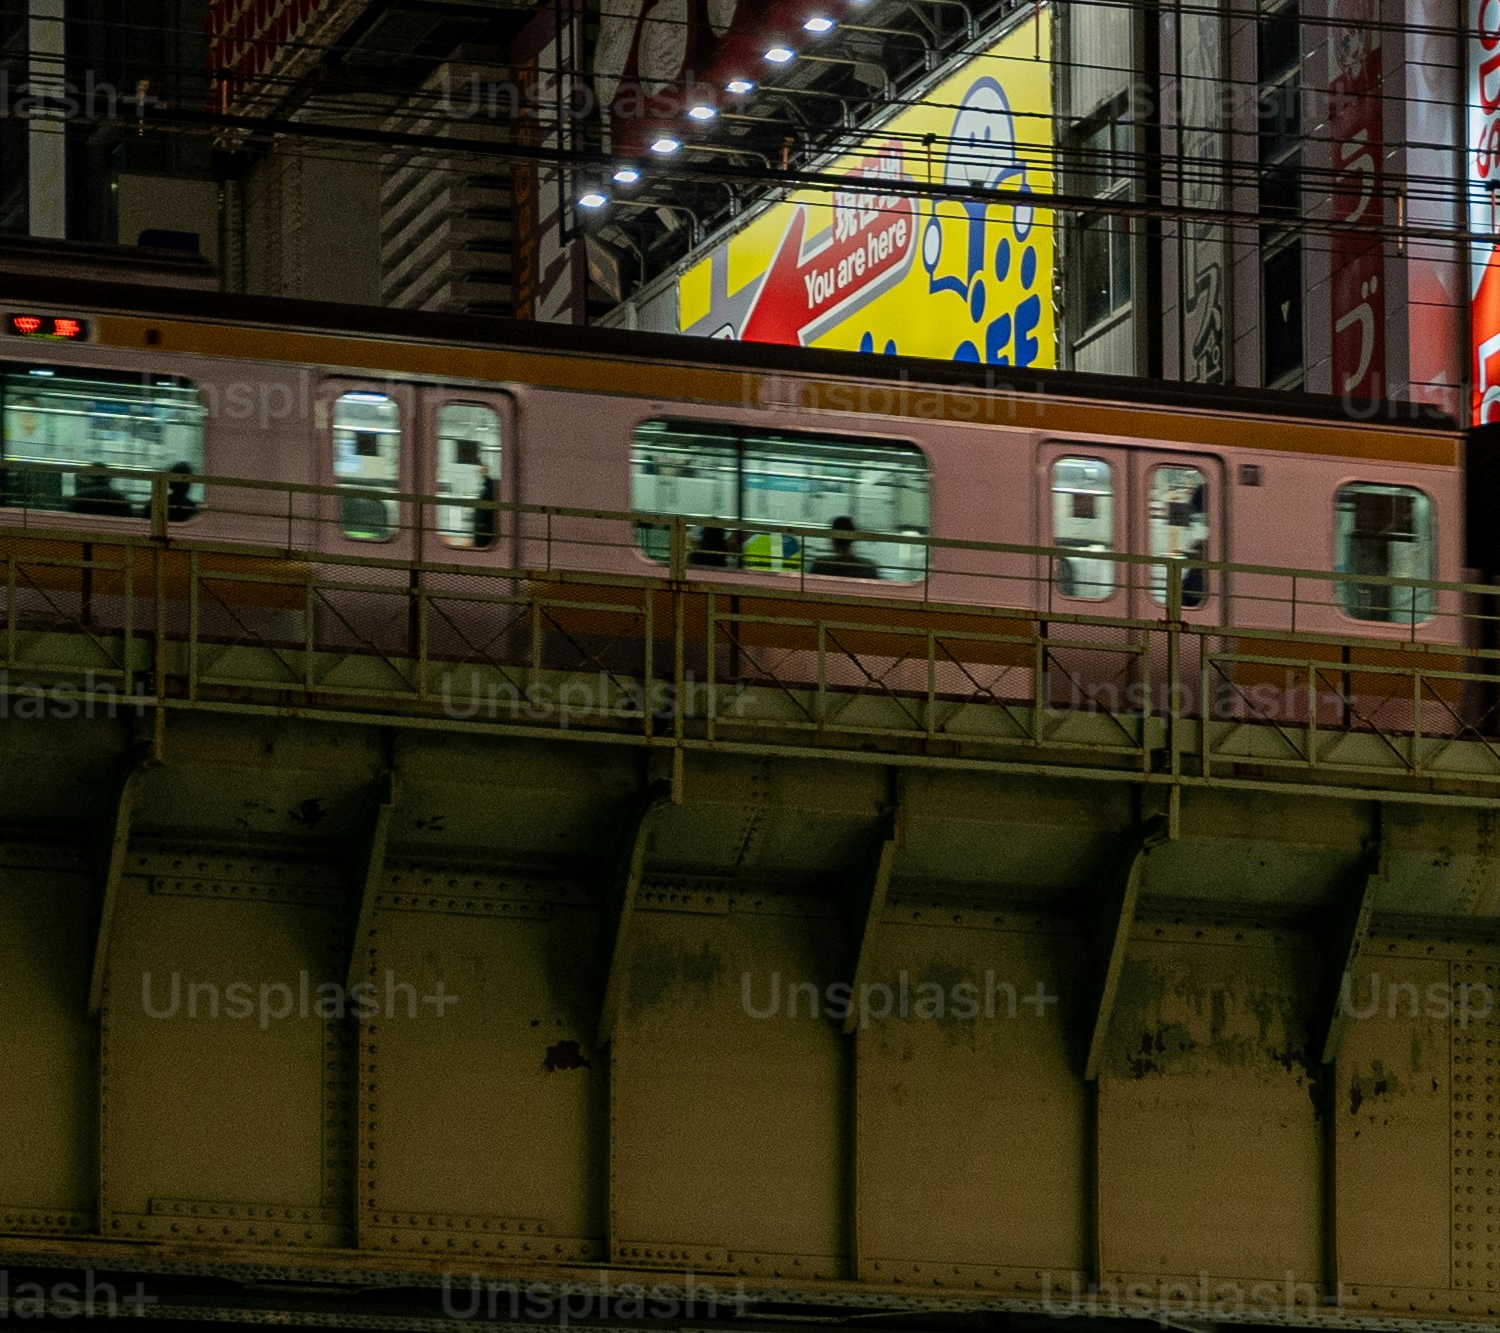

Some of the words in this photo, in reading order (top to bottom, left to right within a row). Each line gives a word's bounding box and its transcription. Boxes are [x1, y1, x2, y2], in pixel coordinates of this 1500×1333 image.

[804, 265, 834, 310] You
[837, 251, 867, 290] are
[867, 218, 907, 270] here
